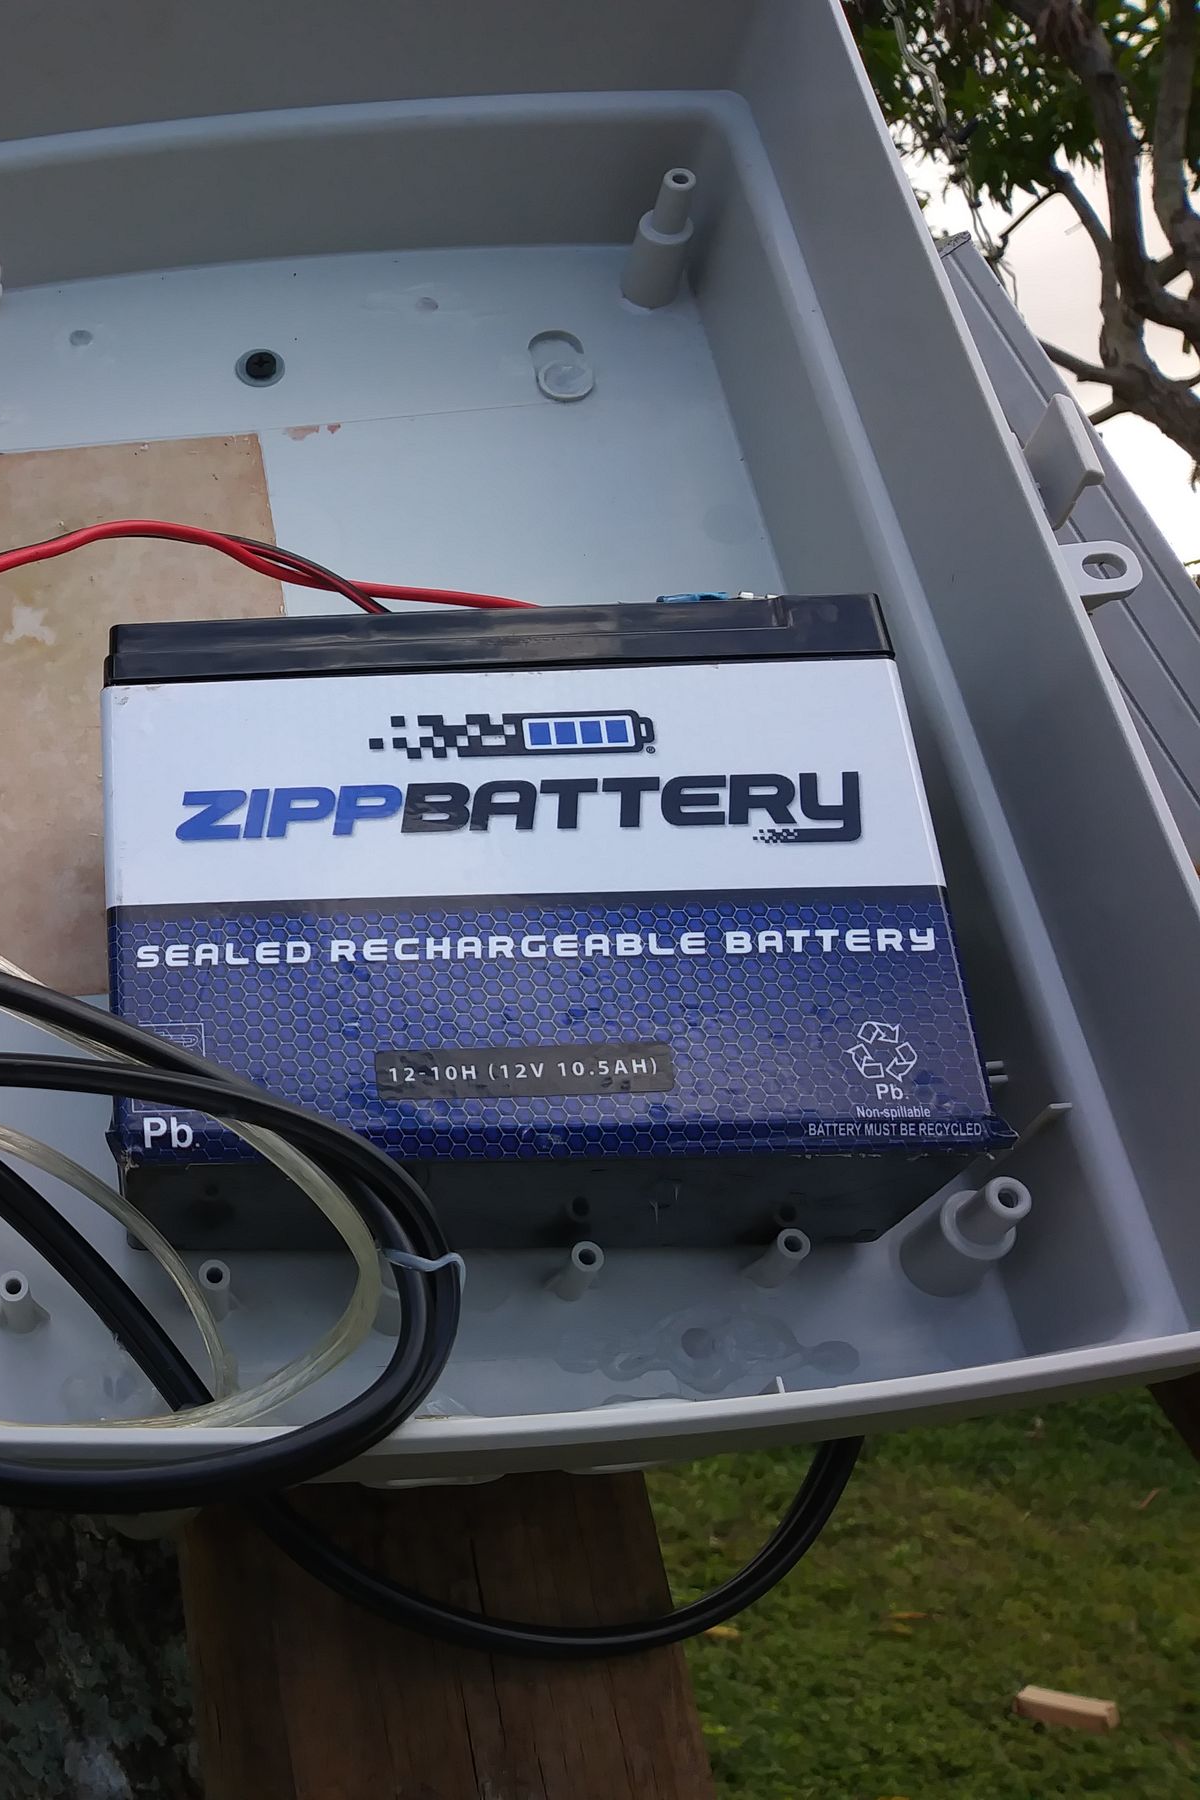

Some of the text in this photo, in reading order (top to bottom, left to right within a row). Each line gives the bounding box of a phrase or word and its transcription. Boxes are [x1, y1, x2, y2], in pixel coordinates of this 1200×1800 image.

[176, 771, 860, 842] ZIPPBATTERY
[137, 926, 936, 968] SEALED RECHARGEABLE BATTERY
[388, 1055, 659, 1083] 12-10H (12V 10.5AH)
[857, 1106, 931, 1120] Non-spillable
[808, 1122, 982, 1136] BATTERY MUST BE RECYCLED
